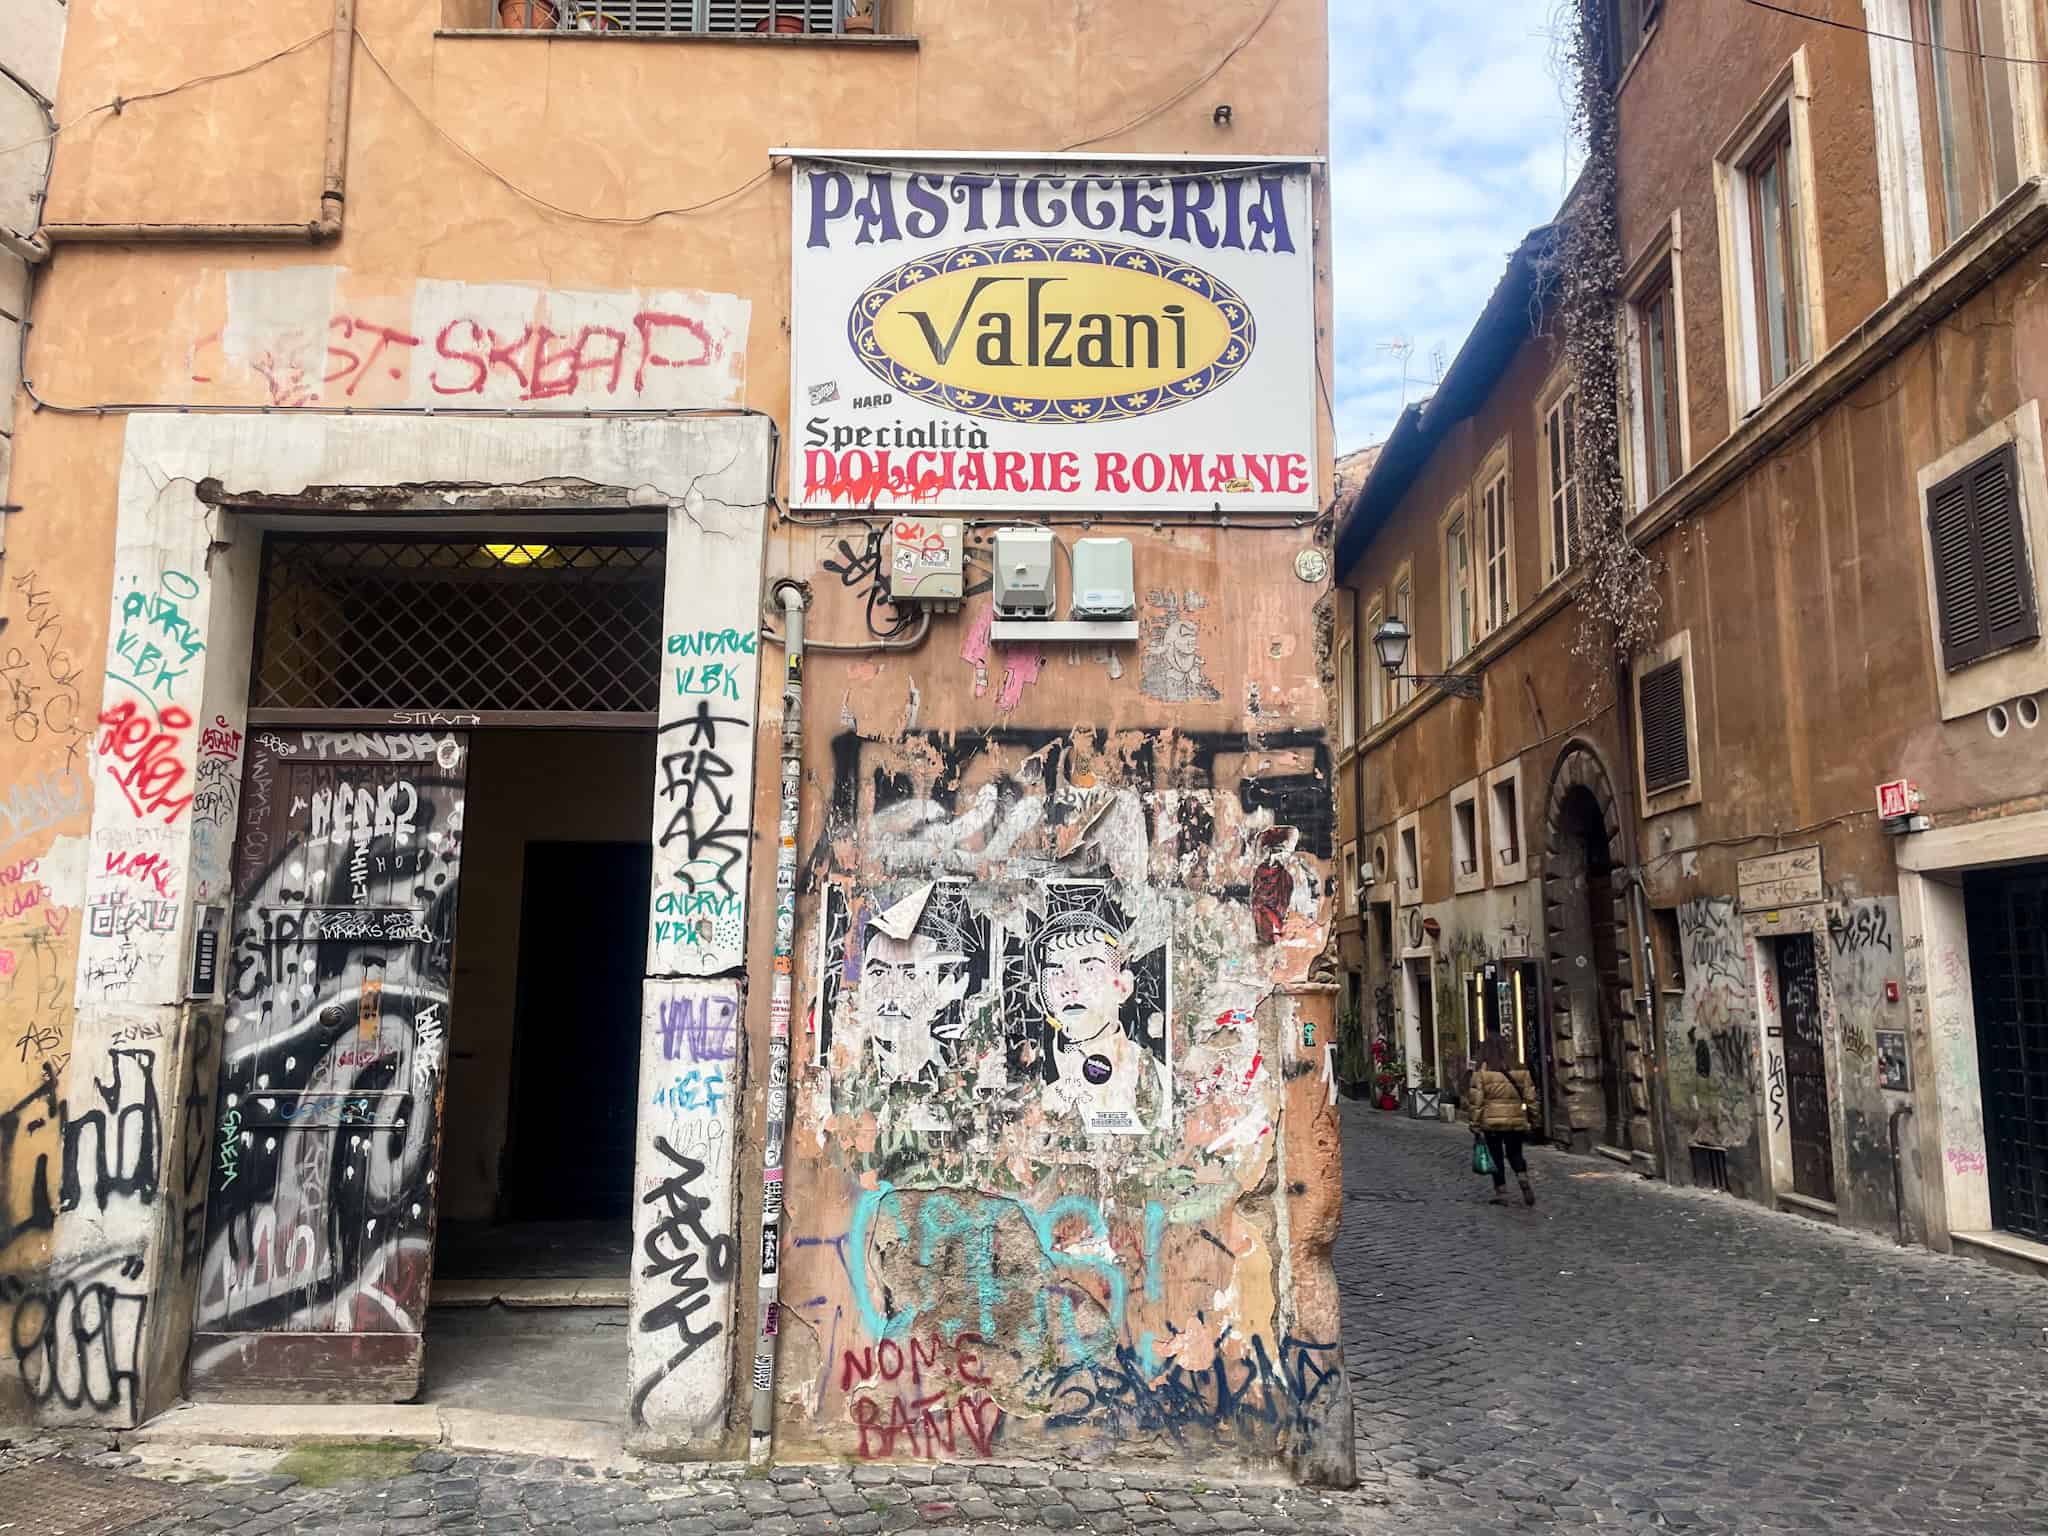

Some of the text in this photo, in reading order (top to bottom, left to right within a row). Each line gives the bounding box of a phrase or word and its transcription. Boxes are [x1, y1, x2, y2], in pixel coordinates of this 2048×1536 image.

[806, 170, 1297, 255] PASTICCERIA
[898, 276, 1187, 369] Valzani
[853, 393, 893, 409] HARD
[804, 416, 989, 453] Specialità
[804, 448, 1310, 494] DOLCIARIE ROMANE
